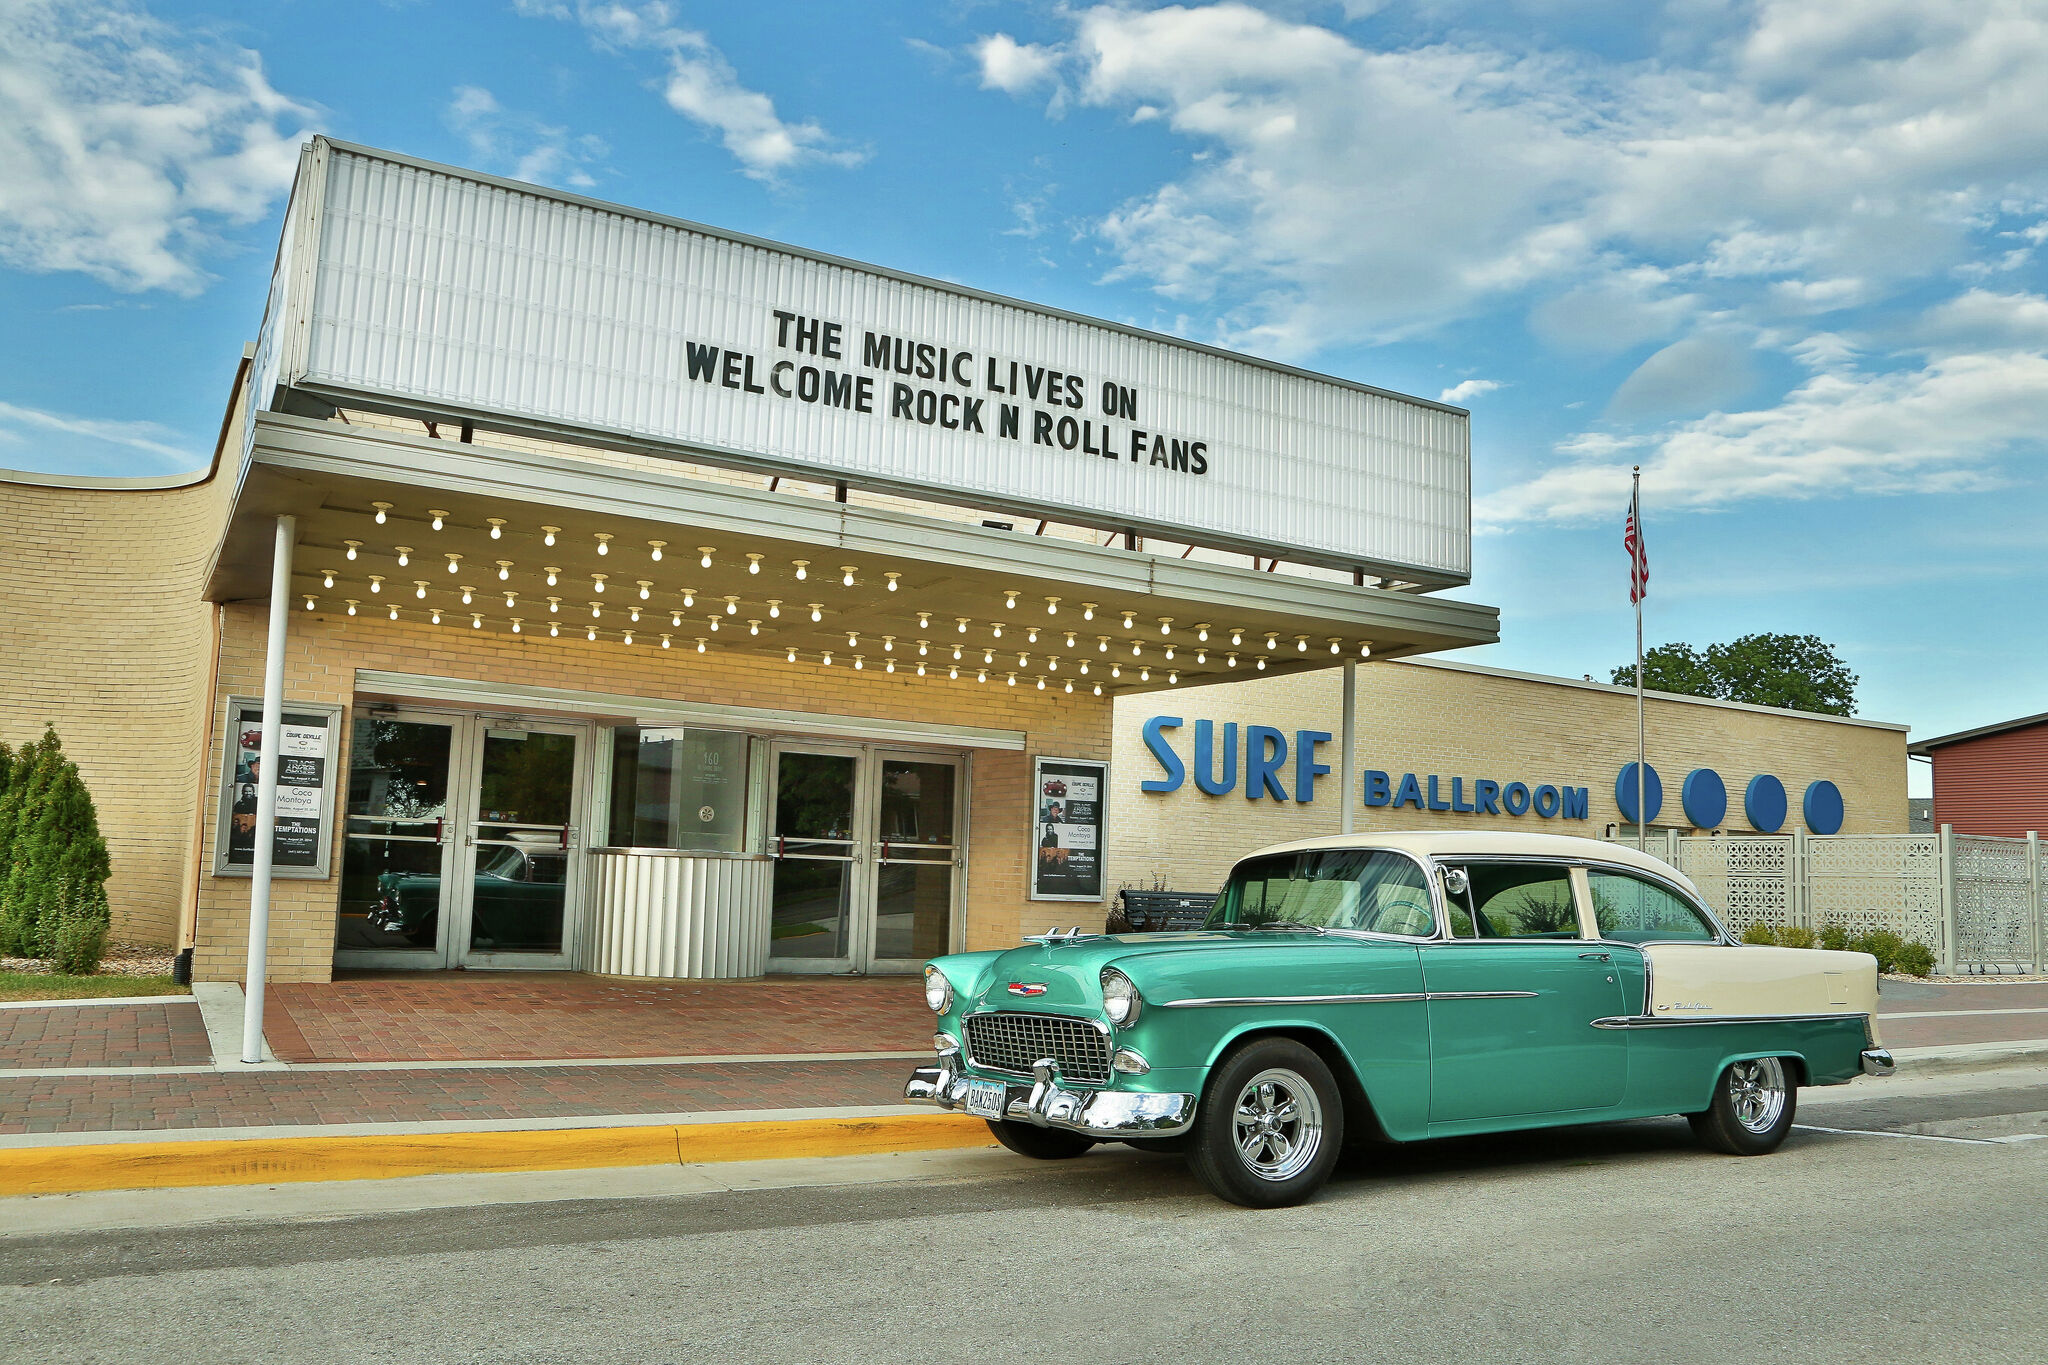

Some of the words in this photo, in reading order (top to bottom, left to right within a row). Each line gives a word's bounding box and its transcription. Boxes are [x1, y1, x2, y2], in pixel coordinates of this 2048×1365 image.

[773, 309, 842, 360] THE
[863, 331, 973, 387] MUSIC
[987, 357, 1084, 409] LIVES
[1102, 381, 1137, 421] ON
[686, 341, 874, 413] WELCOME
[892, 382, 984, 434] ROCK
[1000, 403, 1020, 440] N
[1033, 410, 1119, 460] ROLL
[1131, 430, 1209, 475] FANS
[1141, 715, 1332, 802] SURF
[277, 796, 311, 805] Montoya
[292, 788, 312, 796] Coco
[1364, 770, 1589, 819] BALLROOM
[275, 826, 316, 834] TEMPTATIONS
